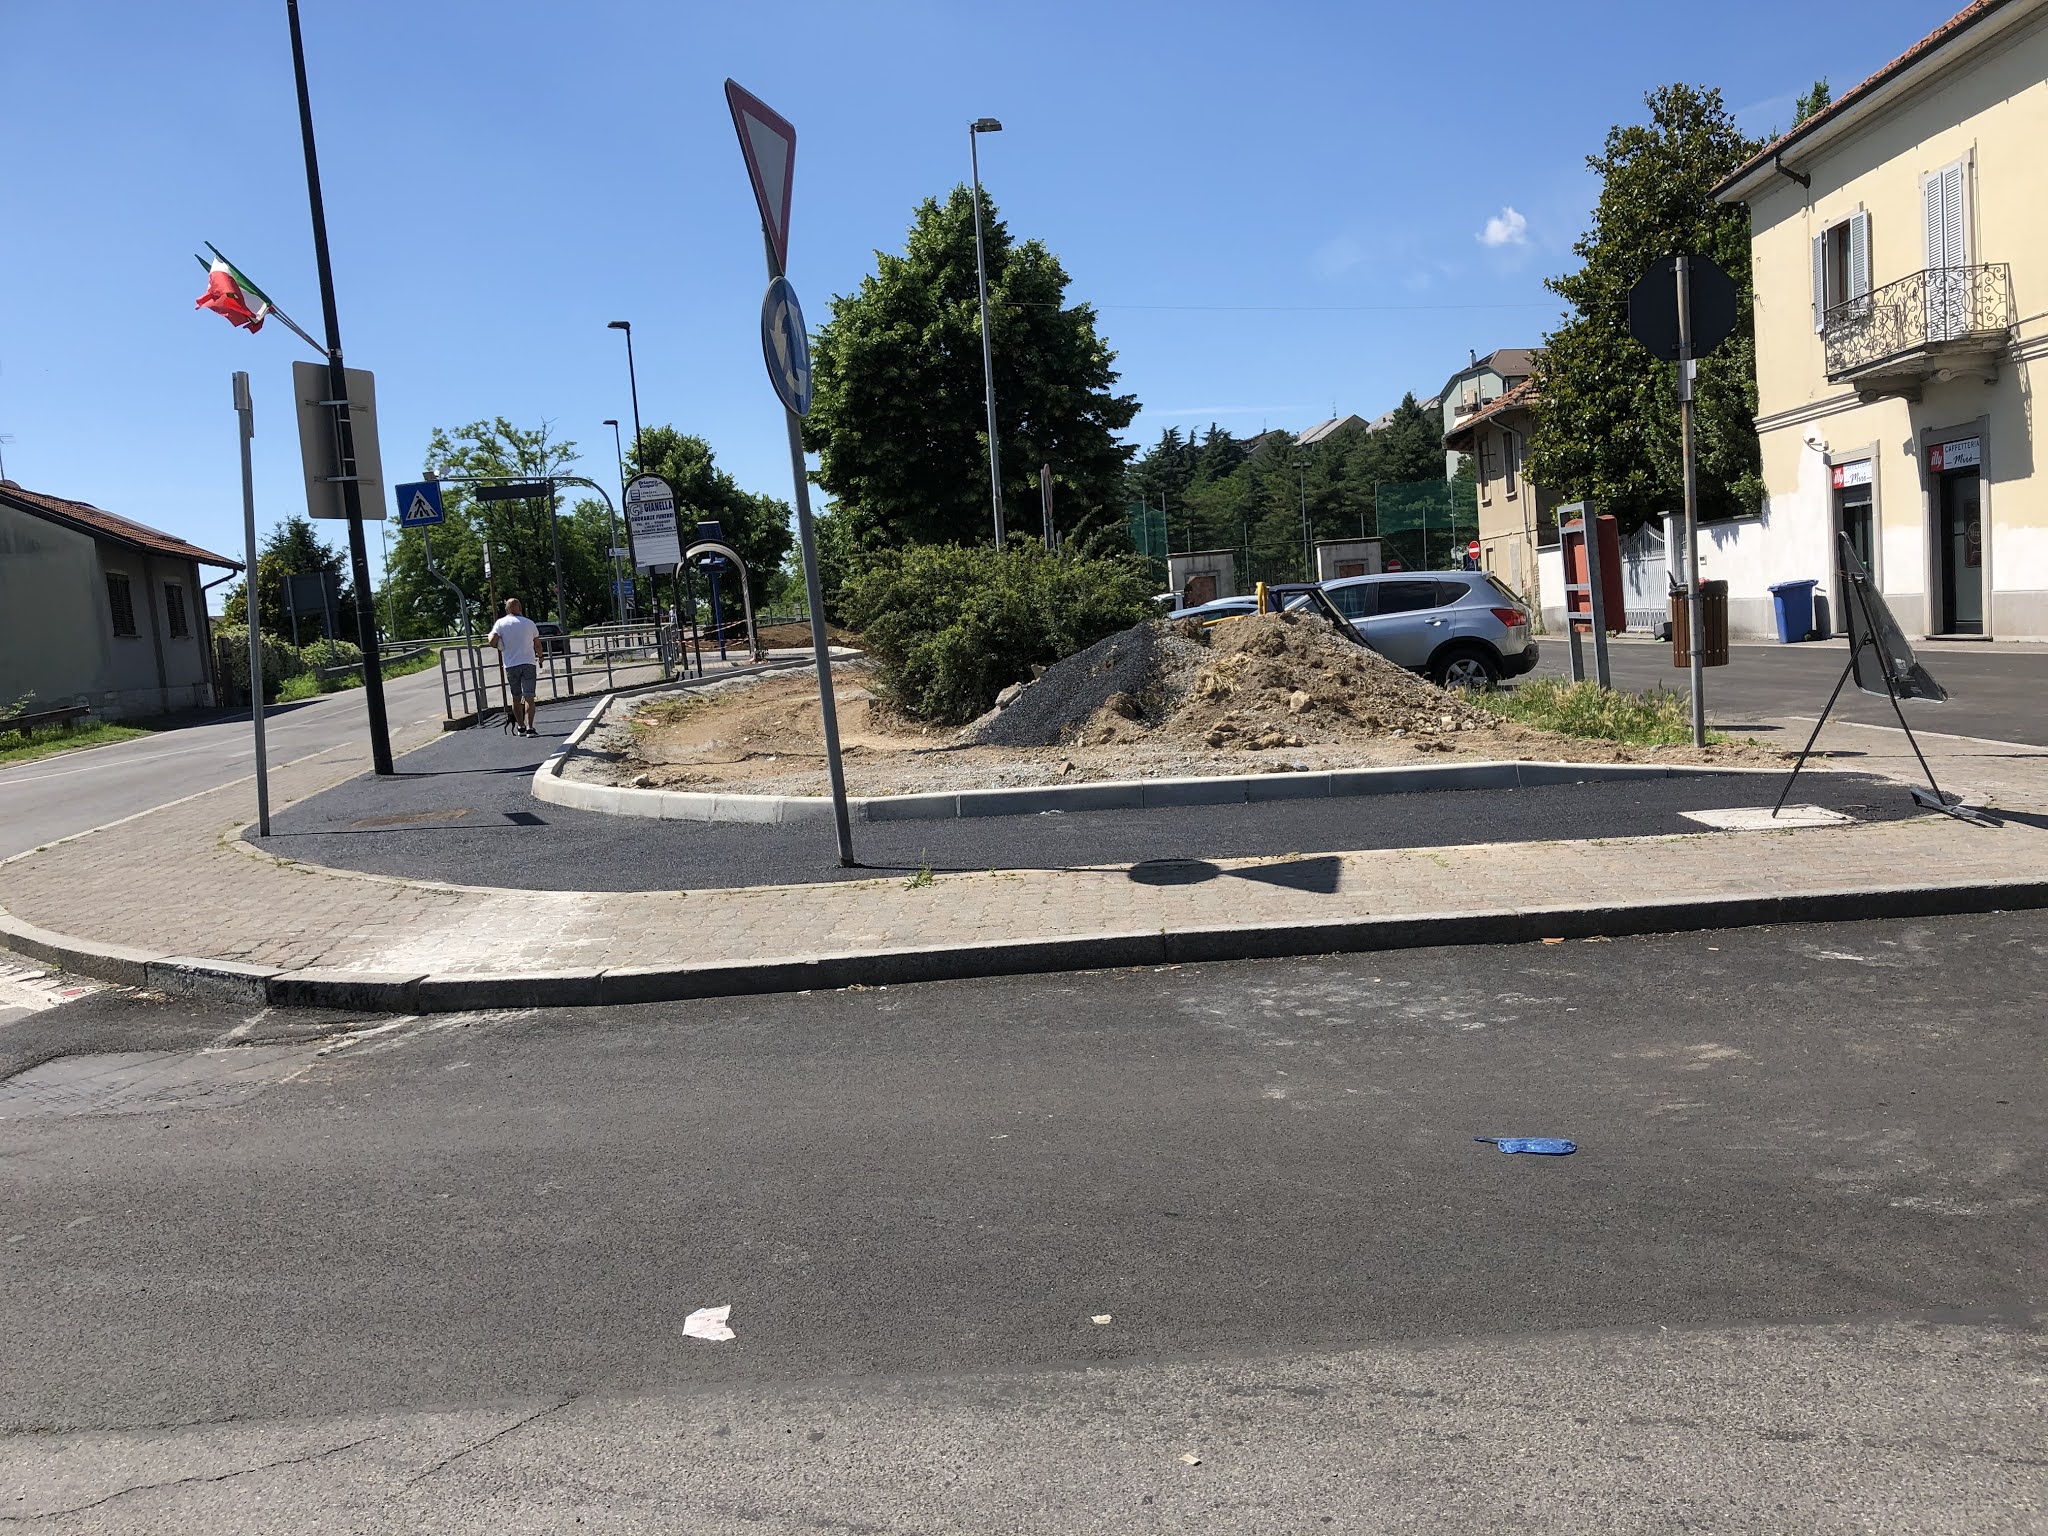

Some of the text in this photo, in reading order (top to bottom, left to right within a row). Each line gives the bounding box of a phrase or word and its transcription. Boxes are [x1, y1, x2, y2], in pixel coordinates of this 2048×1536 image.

[1945, 441, 1979, 453] CAFFETTERIA
[1931, 450, 1943, 469] illy
[1834, 468, 1844, 487] illy
[644, 500, 673, 512] GIANELLA
